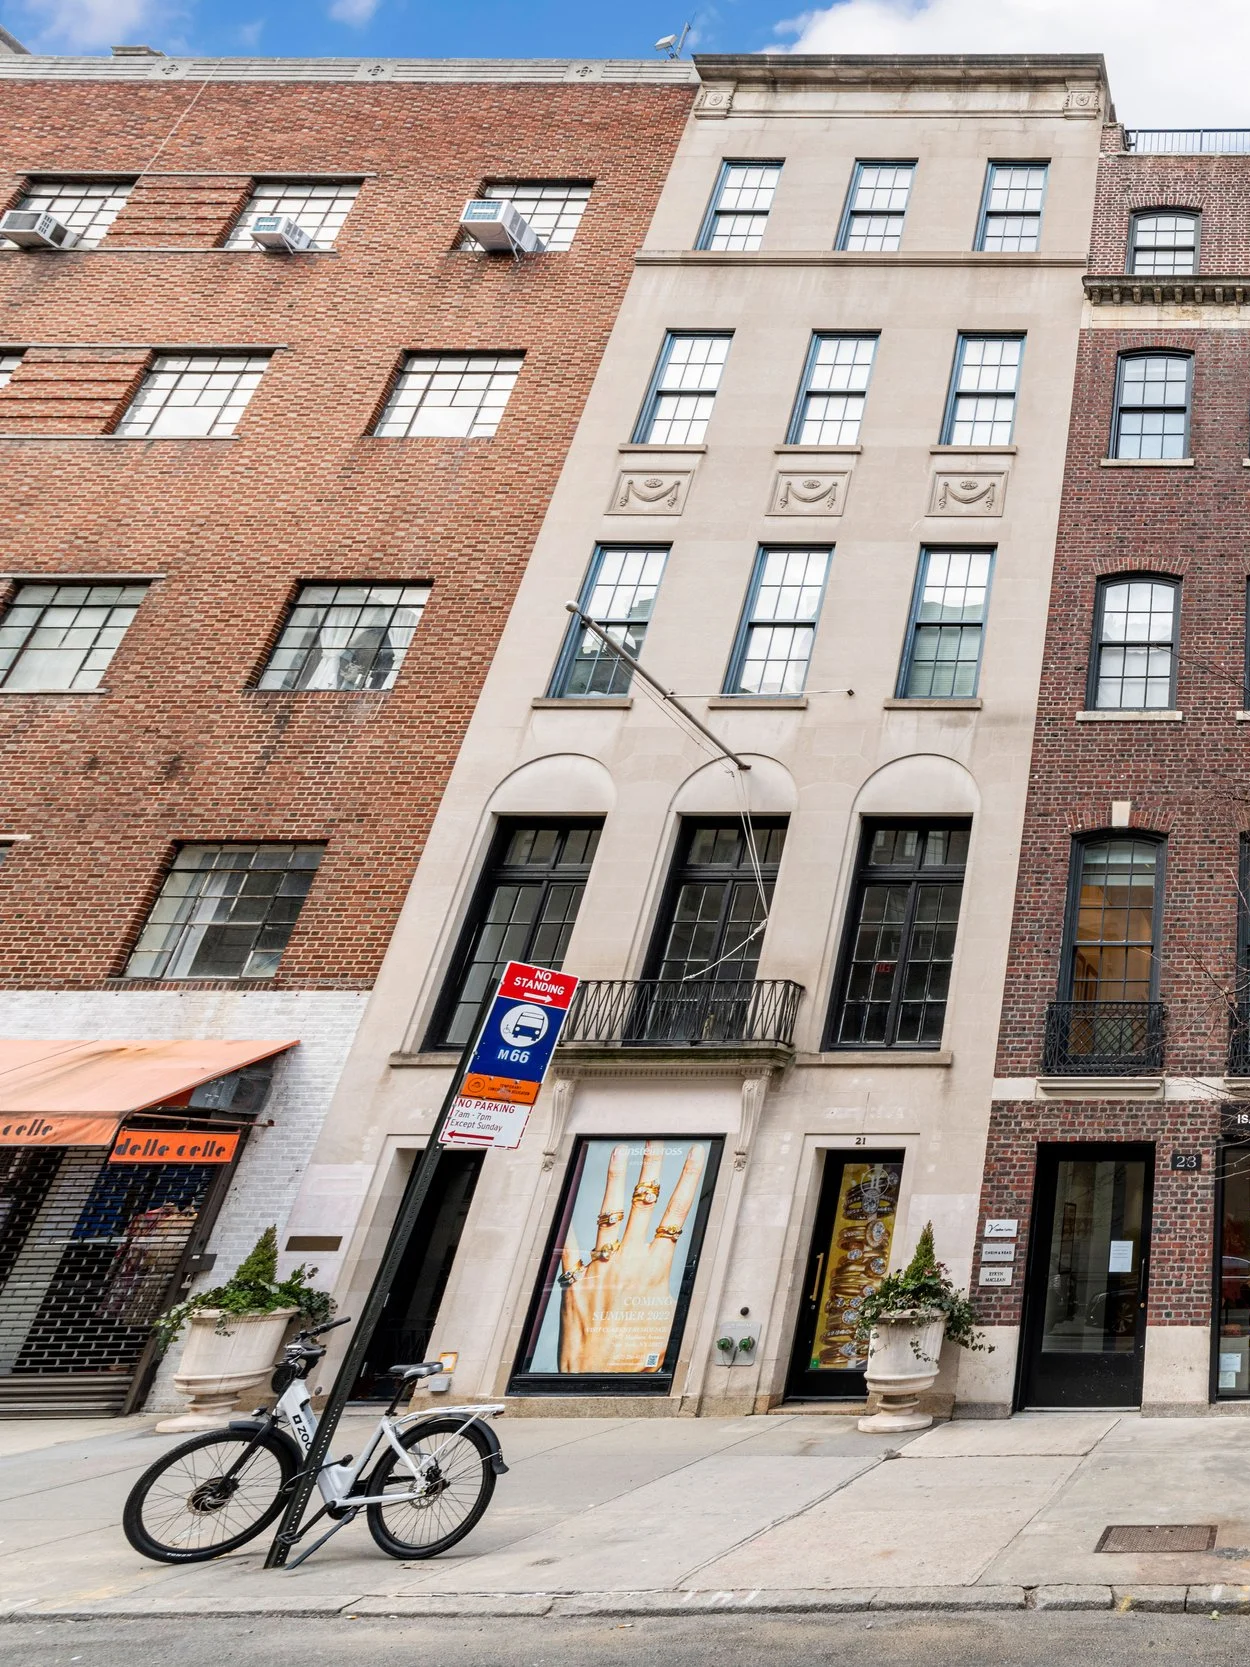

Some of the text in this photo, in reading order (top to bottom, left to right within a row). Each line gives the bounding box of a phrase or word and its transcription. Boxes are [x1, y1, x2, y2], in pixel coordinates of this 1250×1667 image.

[534, 969, 552, 982] NO
[513, 976, 566, 996] STANDING
[457, 1099, 516, 1114] NO PARKING
[453, 1109, 470, 1119] 7am
[476, 1111, 492, 1122] 7pm
[450, 1118, 503, 1132] Except Sunday
[114, 1138, 226, 1157] delle celle
[855, 1137, 867, 1145] 21
[1176, 1155, 1197, 1168] 23
[623, 1295, 673, 1307] COMING
[592, 1310, 670, 1321] SUMMER 2022
[297, 1425, 312, 1451] ZOO
